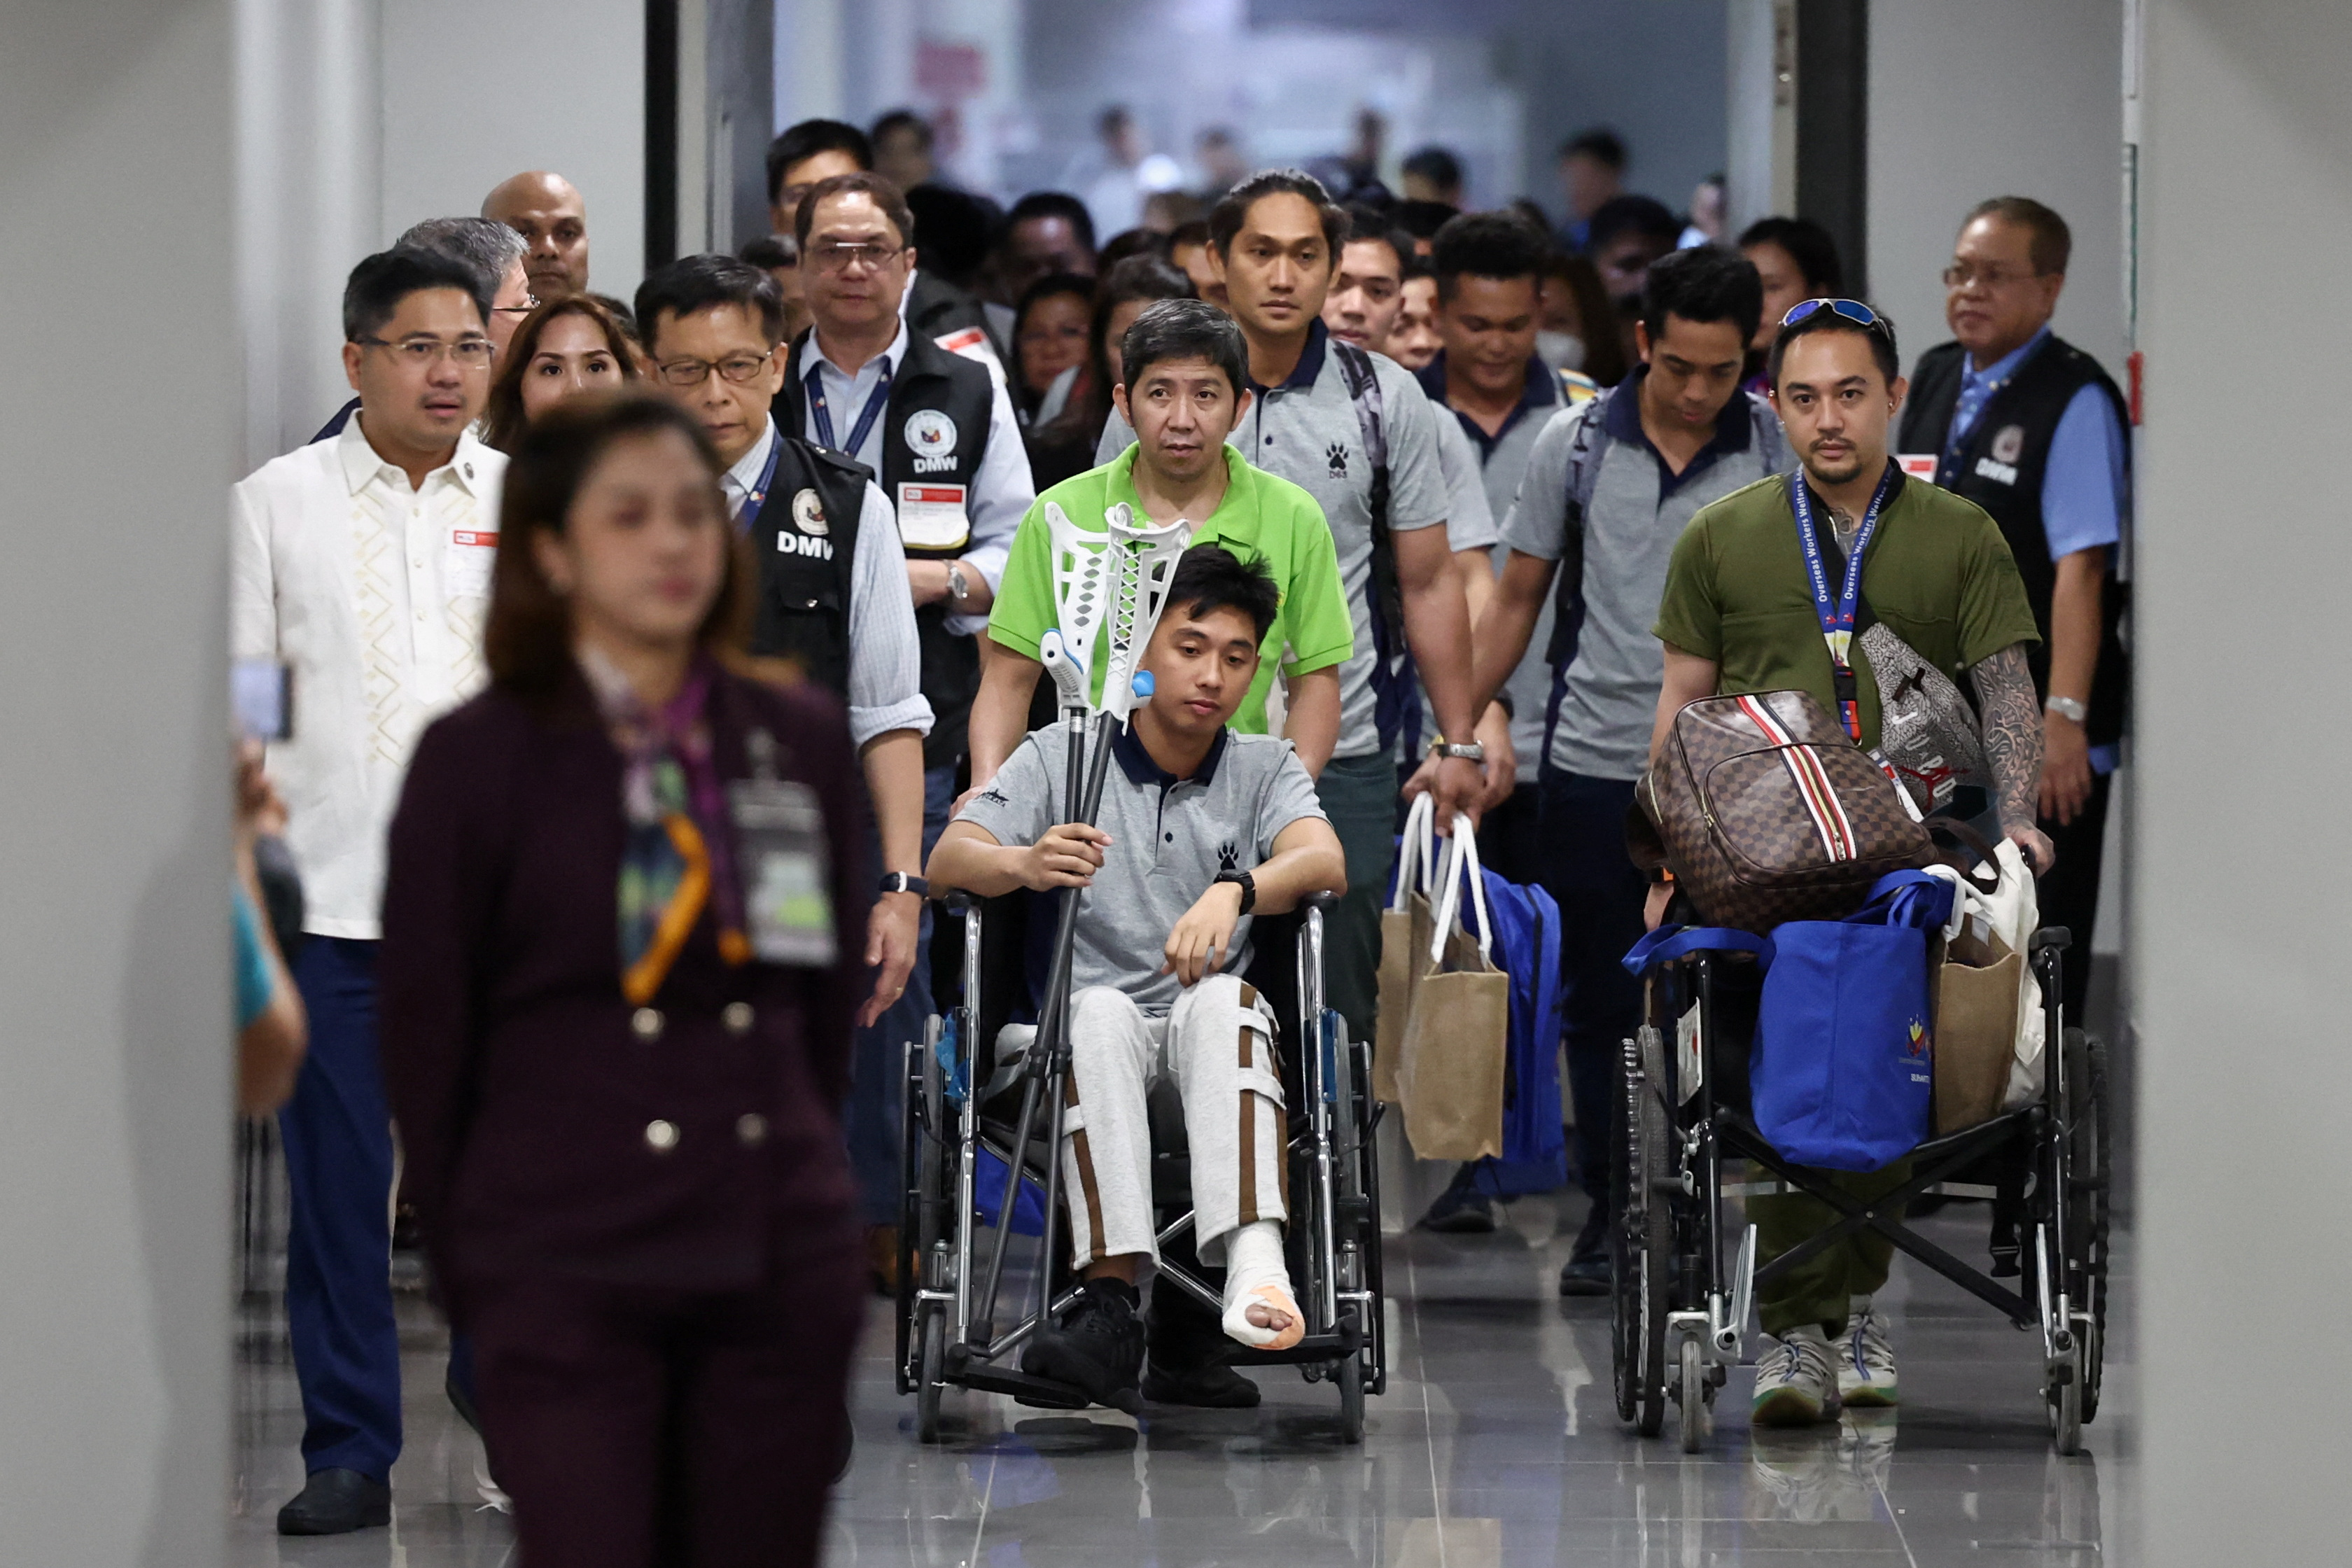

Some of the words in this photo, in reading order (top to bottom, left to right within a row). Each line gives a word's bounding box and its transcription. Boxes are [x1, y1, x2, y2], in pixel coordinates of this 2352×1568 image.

[913, 456, 958, 474] DMW
[1796, 484, 1807, 517] Welfare
[1802, 518, 1817, 558] Workers
[1844, 556, 1858, 599] Overseas
[1854, 519, 1874, 554] Workers
[1811, 559, 1828, 602] Overseas
